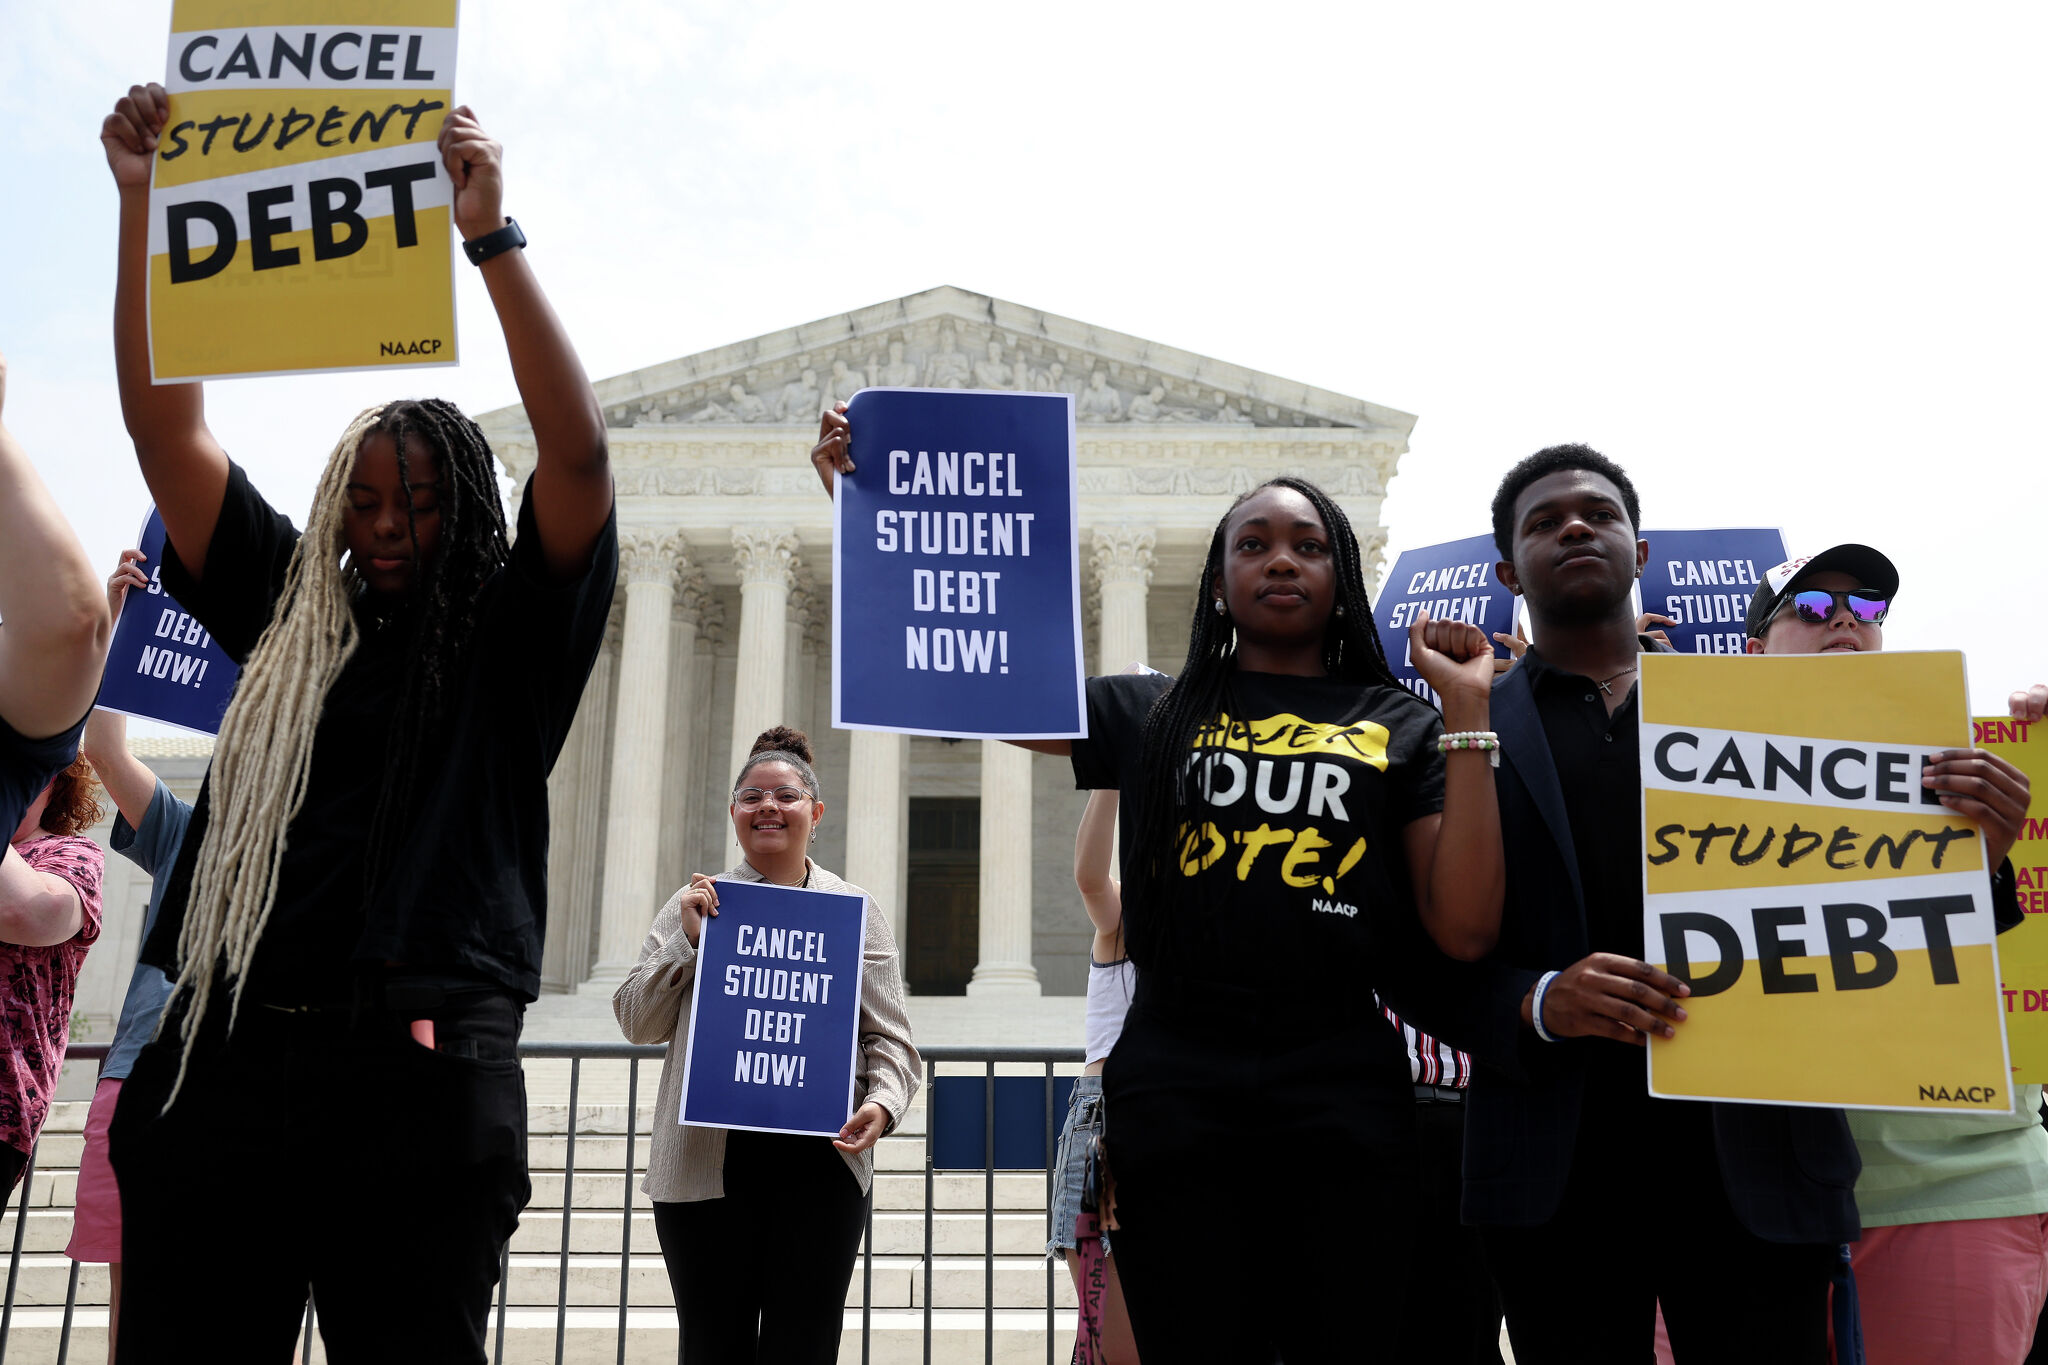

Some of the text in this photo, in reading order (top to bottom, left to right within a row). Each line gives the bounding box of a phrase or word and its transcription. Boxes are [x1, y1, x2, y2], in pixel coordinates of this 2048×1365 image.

[179, 32, 435, 82] CANCEL
[161, 99, 444, 161] STUDENT
[166, 161, 436, 284] DEBT
[380, 340, 442, 357] NAACP
[888, 450, 1023, 497] CANCEL
[876, 509, 1035, 557] STUDENT
[913, 568, 1001, 615] DEBT
[1407, 562, 1490, 595] CANCEL
[1667, 559, 1762, 586] CANCEL
[1665, 593, 1755, 625] STUDE
[906, 625, 1009, 674] NOW!
[1695, 633, 1748, 654] DEB
[136, 644, 209, 689] NOW!
[1972, 720, 2033, 744] DENT
[1646, 822, 1975, 870] STUDENT
[1312, 898, 1359, 918] NAACP
[736, 924, 827, 963] CANCEL
[1659, 893, 1976, 998] DEBT
[724, 964, 833, 1005] STUDENT
[744, 1008, 806, 1044] DEBT
[734, 1050, 807, 1088] NOW!
[1918, 1084, 1996, 1103] NAACP
[1088, 1257, 1106, 1309] Alpha
